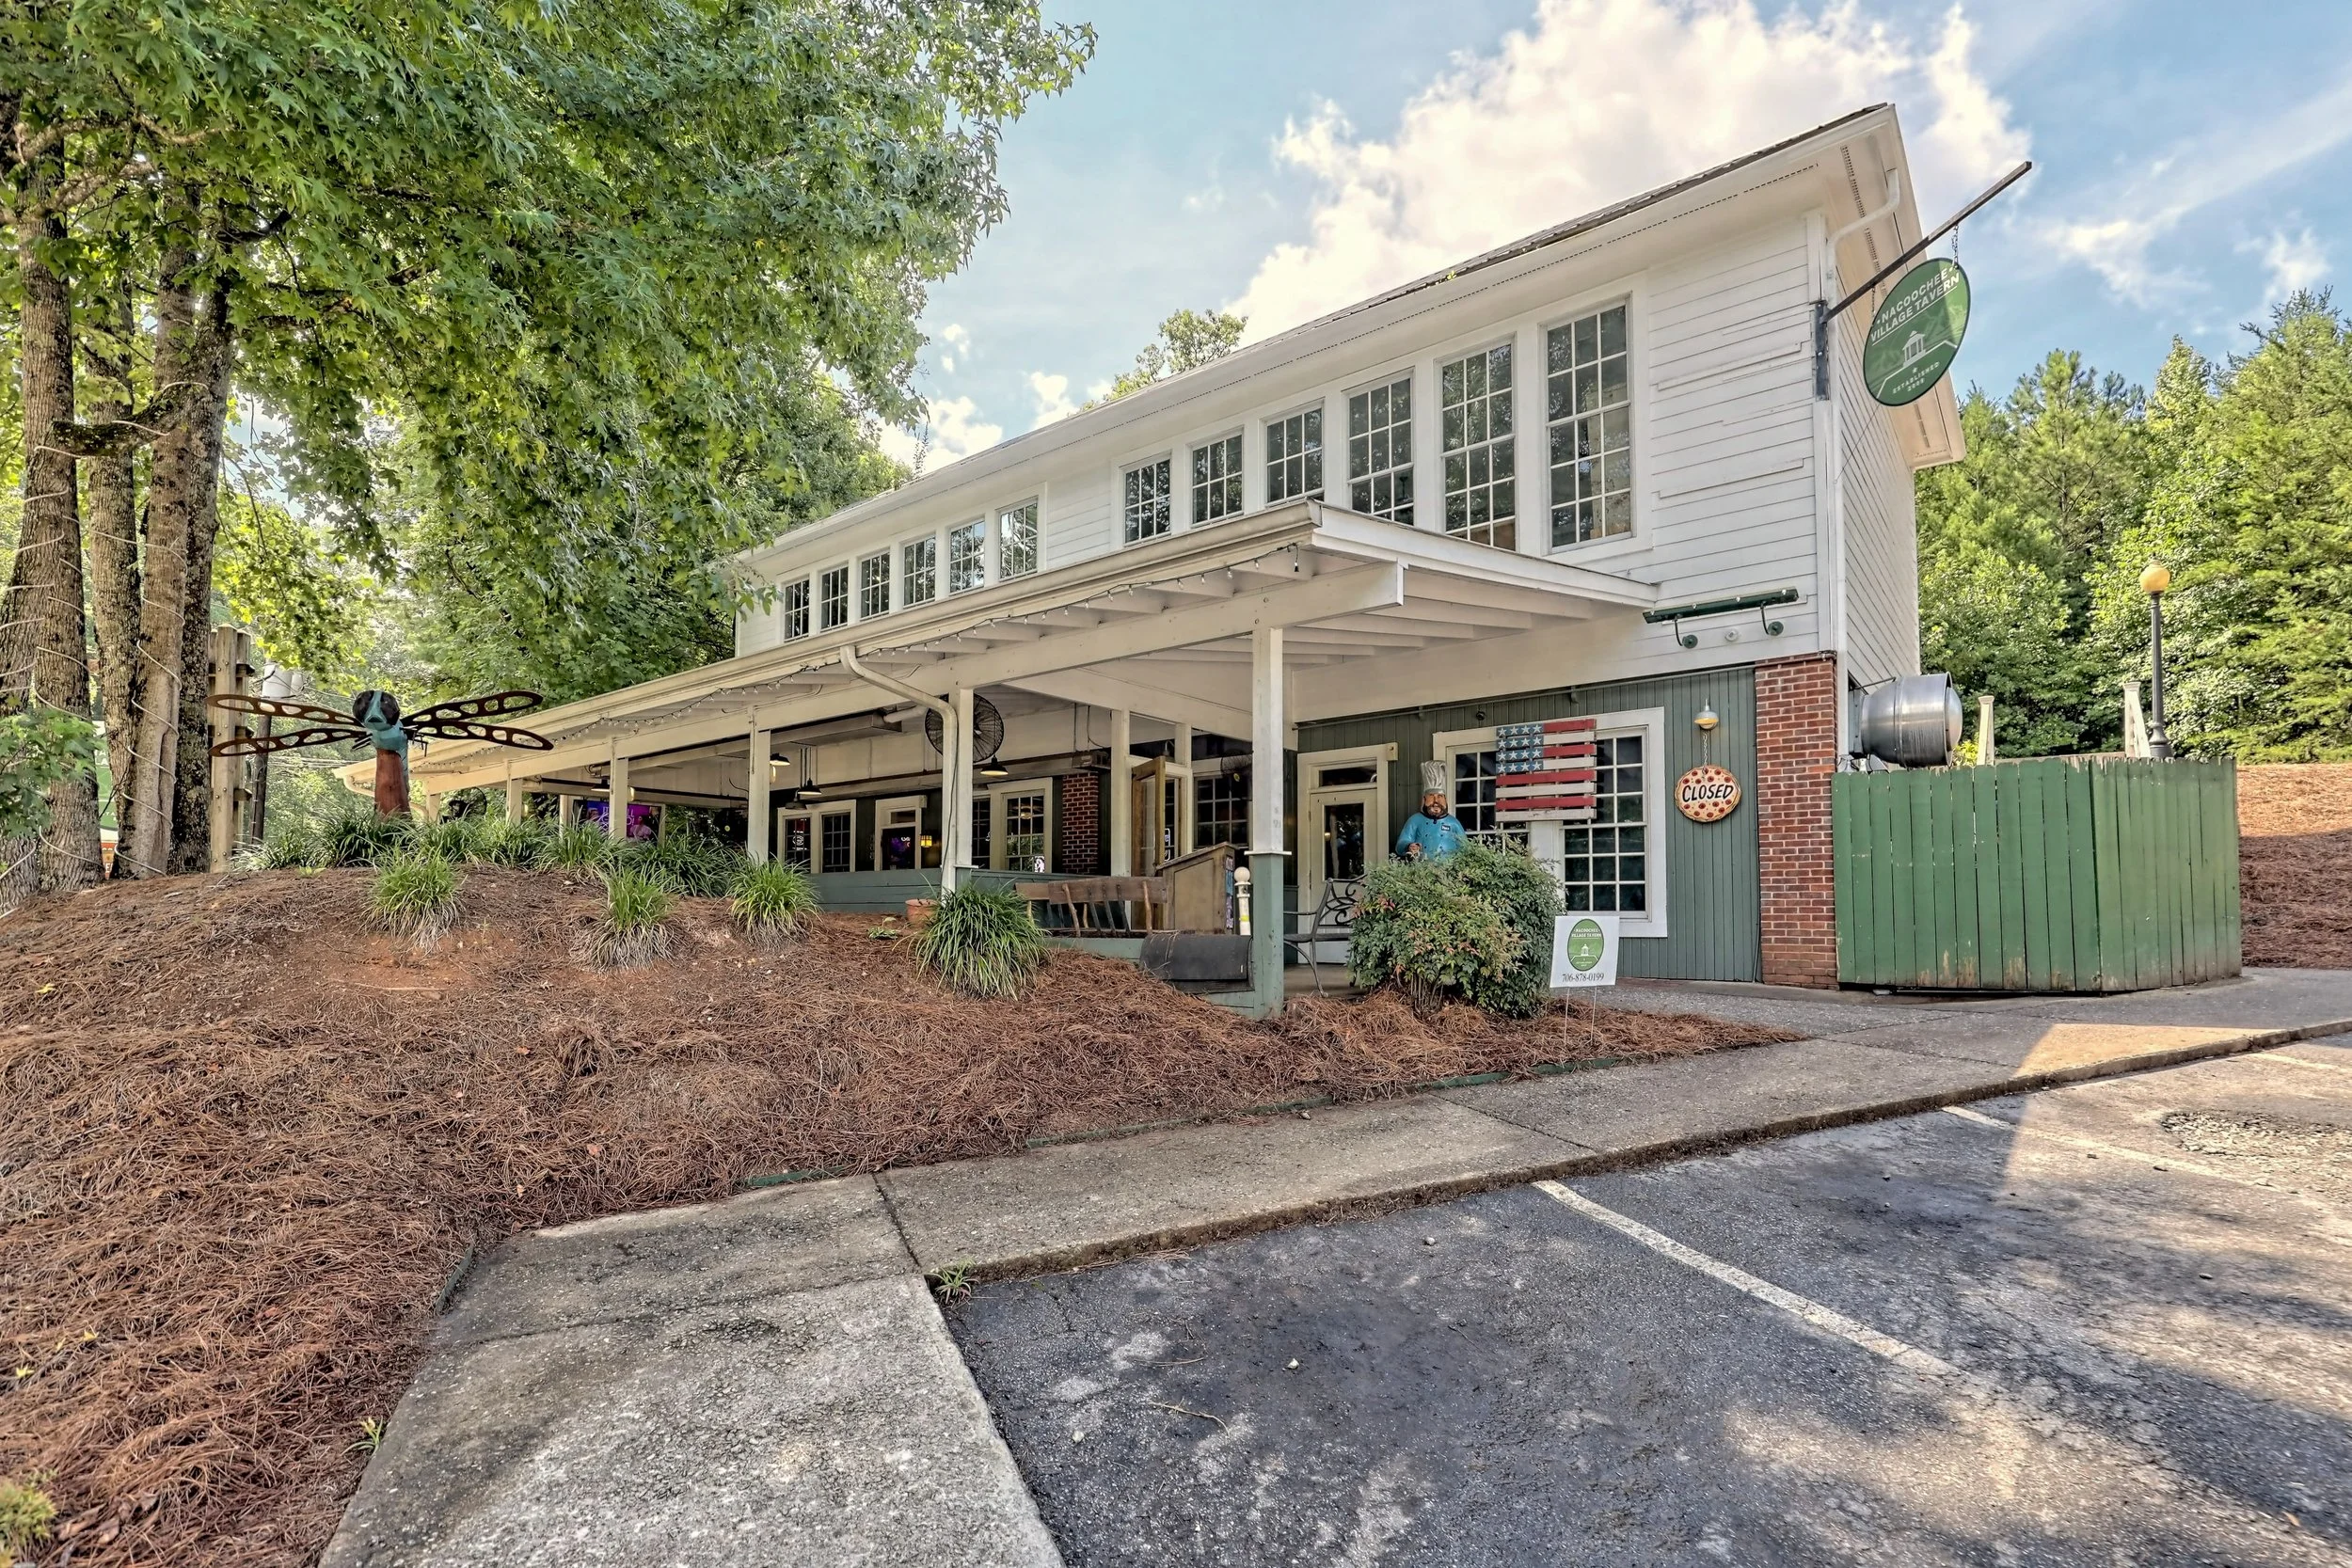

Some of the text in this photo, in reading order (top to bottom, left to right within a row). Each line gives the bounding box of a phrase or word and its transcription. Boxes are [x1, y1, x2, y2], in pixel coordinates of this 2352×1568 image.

[1870, 272, 1960, 341] VILLAGE TAVERN
[1882, 268, 1948, 324] NACOOCHEE
[1892, 361, 1940, 394] ESTABLISHED
[1682, 784, 1734, 802] CLOSED
[1562, 973, 1605, 982] 706-878-0199
